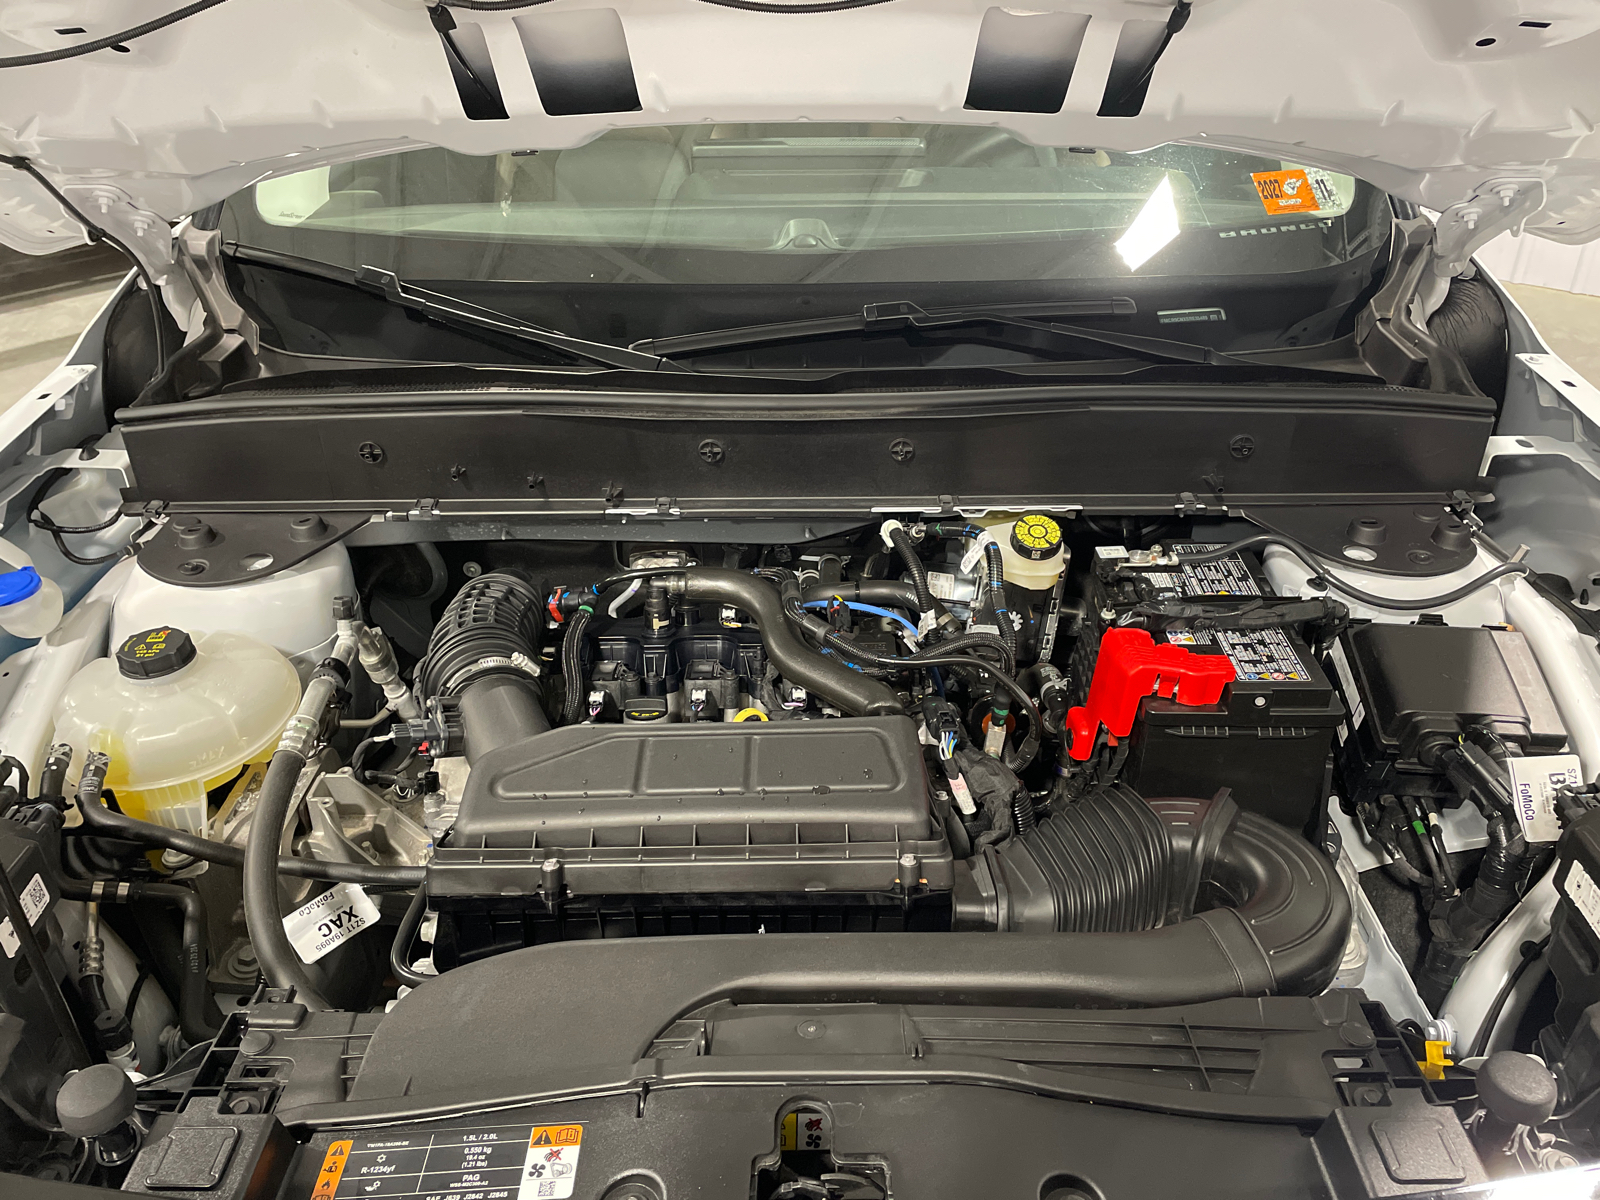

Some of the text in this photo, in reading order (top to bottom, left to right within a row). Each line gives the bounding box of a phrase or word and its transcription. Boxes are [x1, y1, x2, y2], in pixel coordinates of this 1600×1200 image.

[1257, 178, 1283, 200] 2027
[1314, 178, 1332, 201] 11
[1519, 782, 1535, 822] FoMoCo
[298, 891, 336, 917] FoMoCo
[317, 905, 360, 938] XAC
[315, 932, 345, 953] 19A095
[483, 1146, 492, 1154] kg
[360, 1165, 396, 1174] R-1234yf
[462, 1174, 480, 1182] PAG
